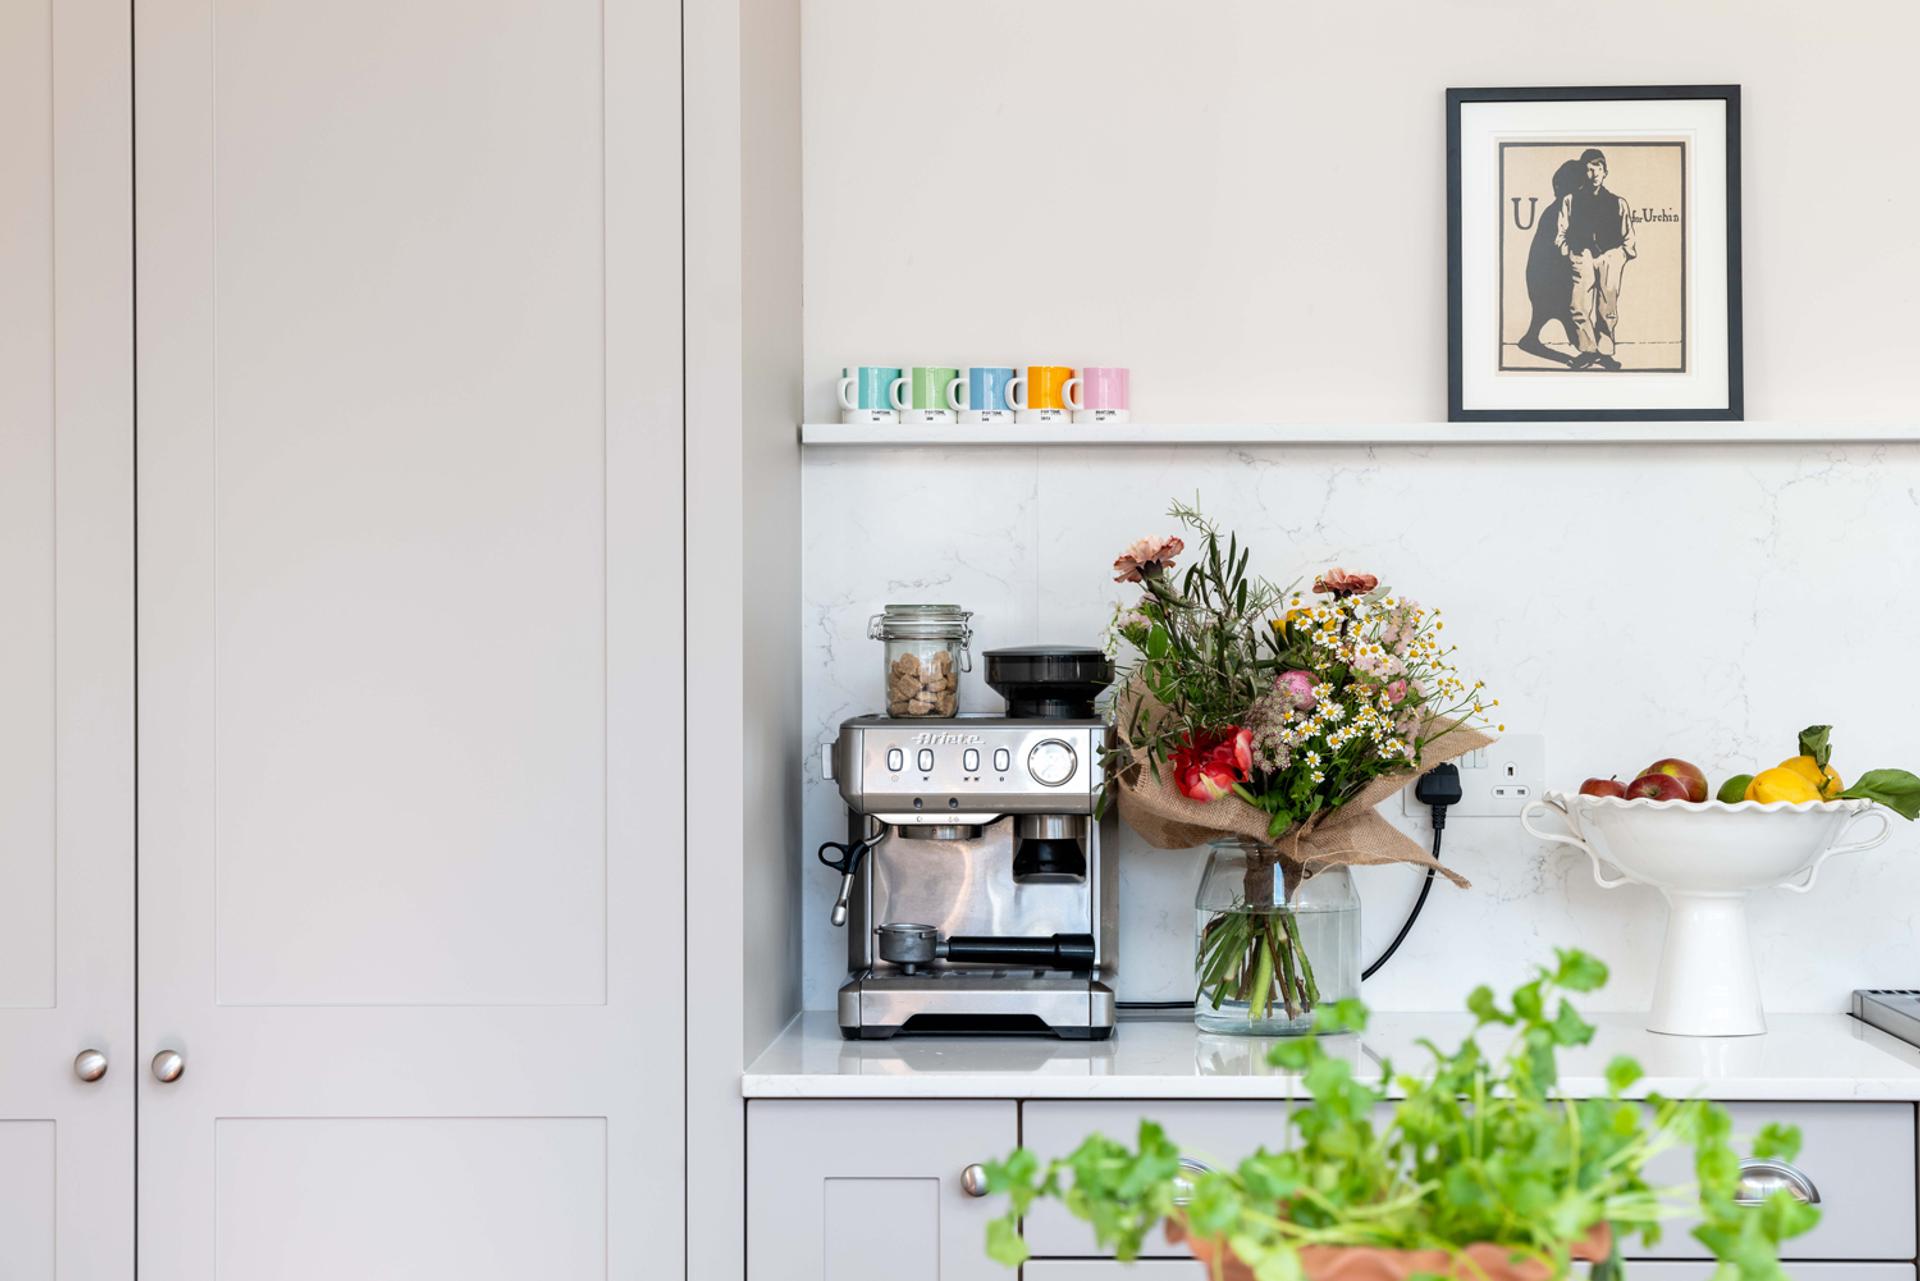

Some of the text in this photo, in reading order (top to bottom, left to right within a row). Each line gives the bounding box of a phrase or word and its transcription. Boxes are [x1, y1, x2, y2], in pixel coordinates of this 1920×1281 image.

[1511, 197, 1679, 230] U for Urchin
